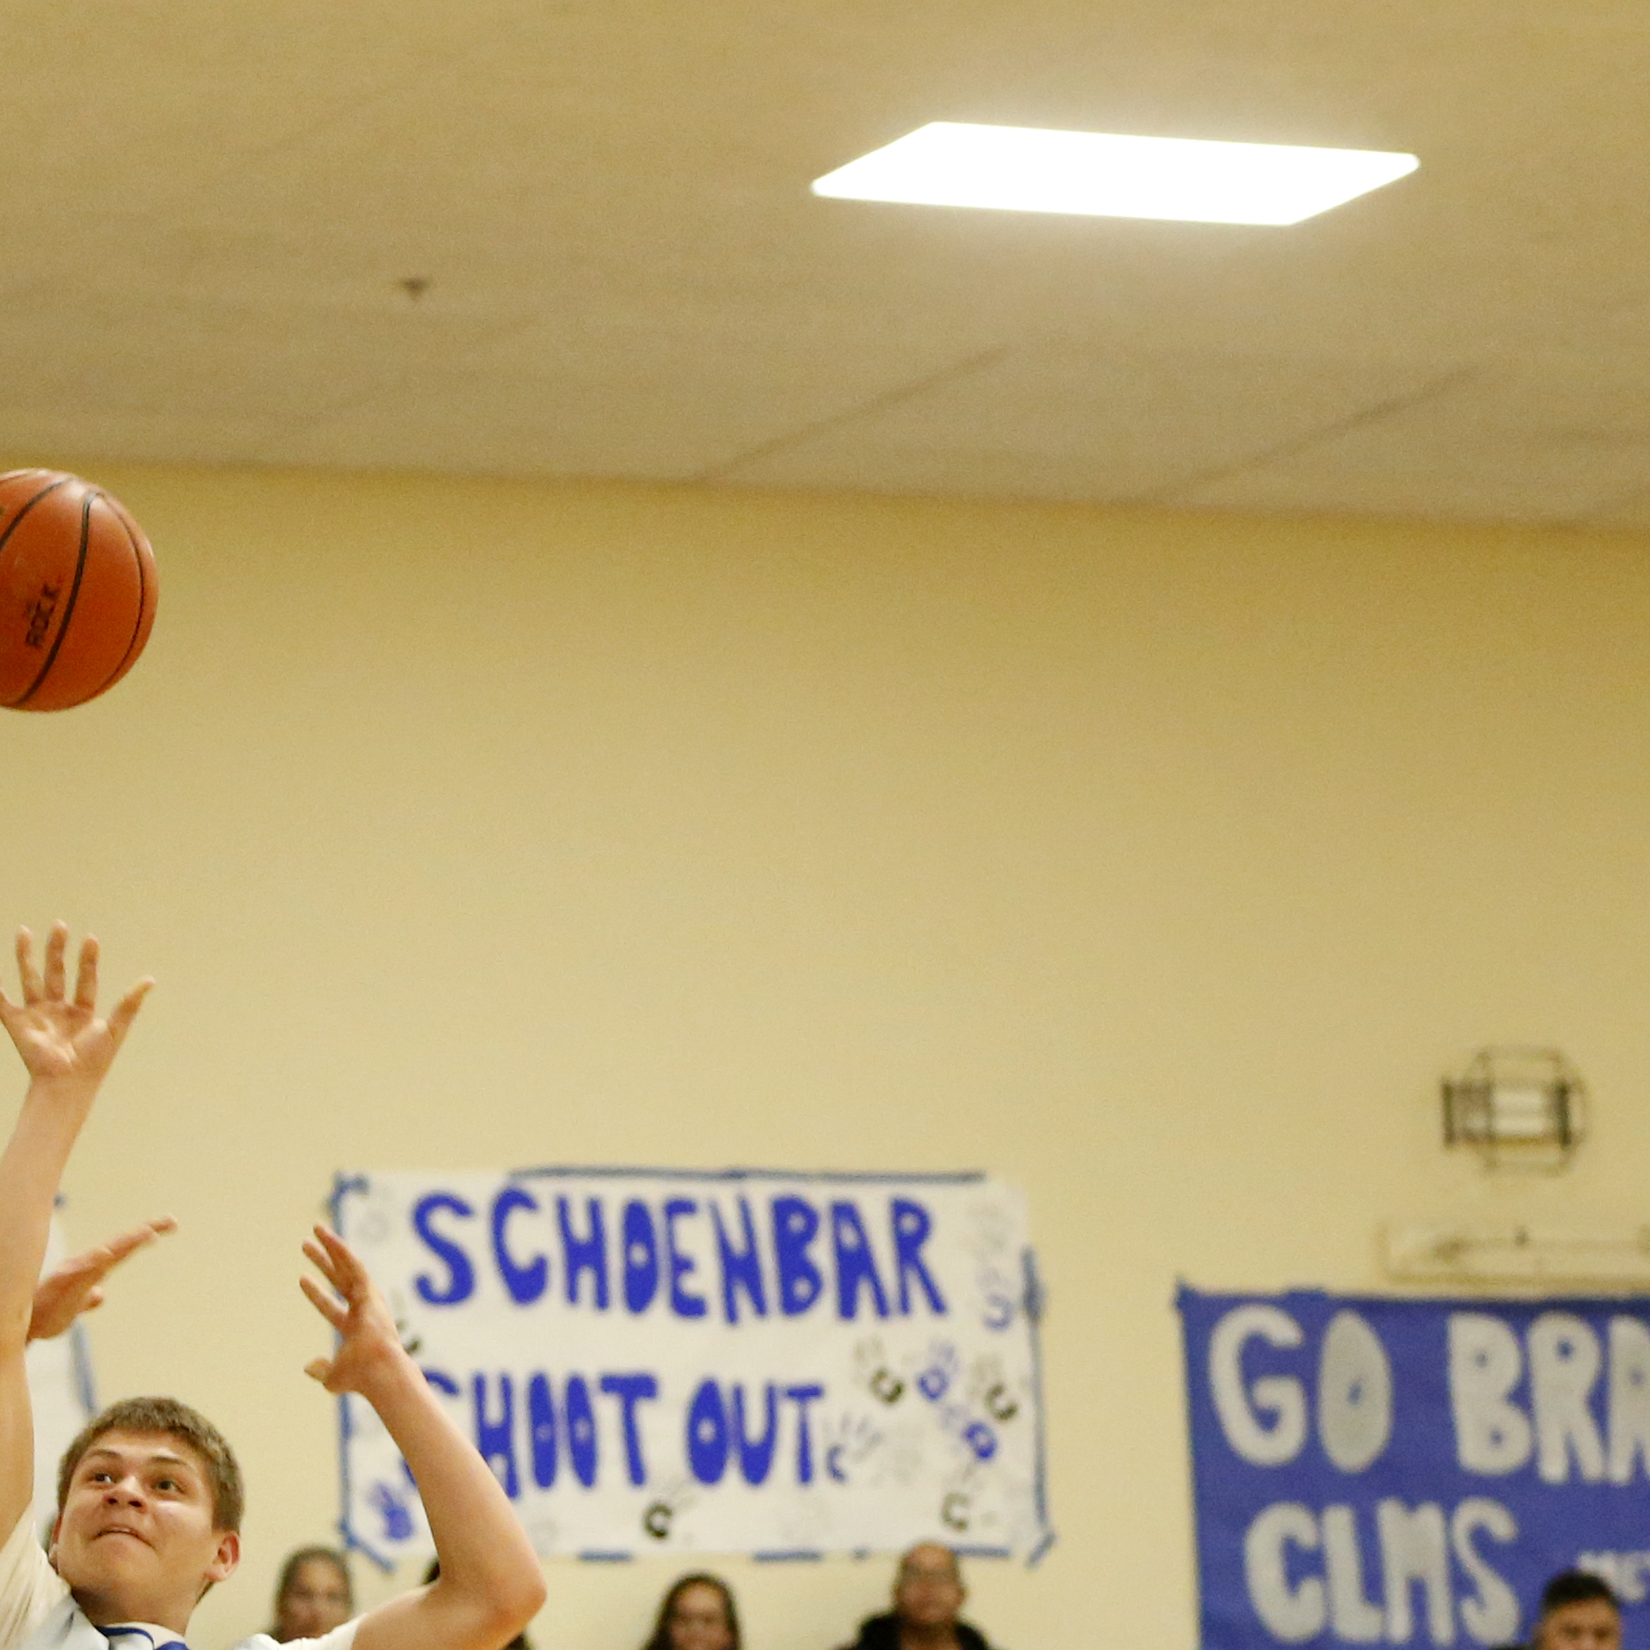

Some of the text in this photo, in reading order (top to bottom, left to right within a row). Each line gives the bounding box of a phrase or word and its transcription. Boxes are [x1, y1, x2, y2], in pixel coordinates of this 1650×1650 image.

[410, 1187, 950, 1326] SCHOENBAR
[400, 1367, 826, 1500] HOOT OUT
[1207, 1303, 1395, 1475] GO
[1243, 1497, 1522, 1648] CLMS
